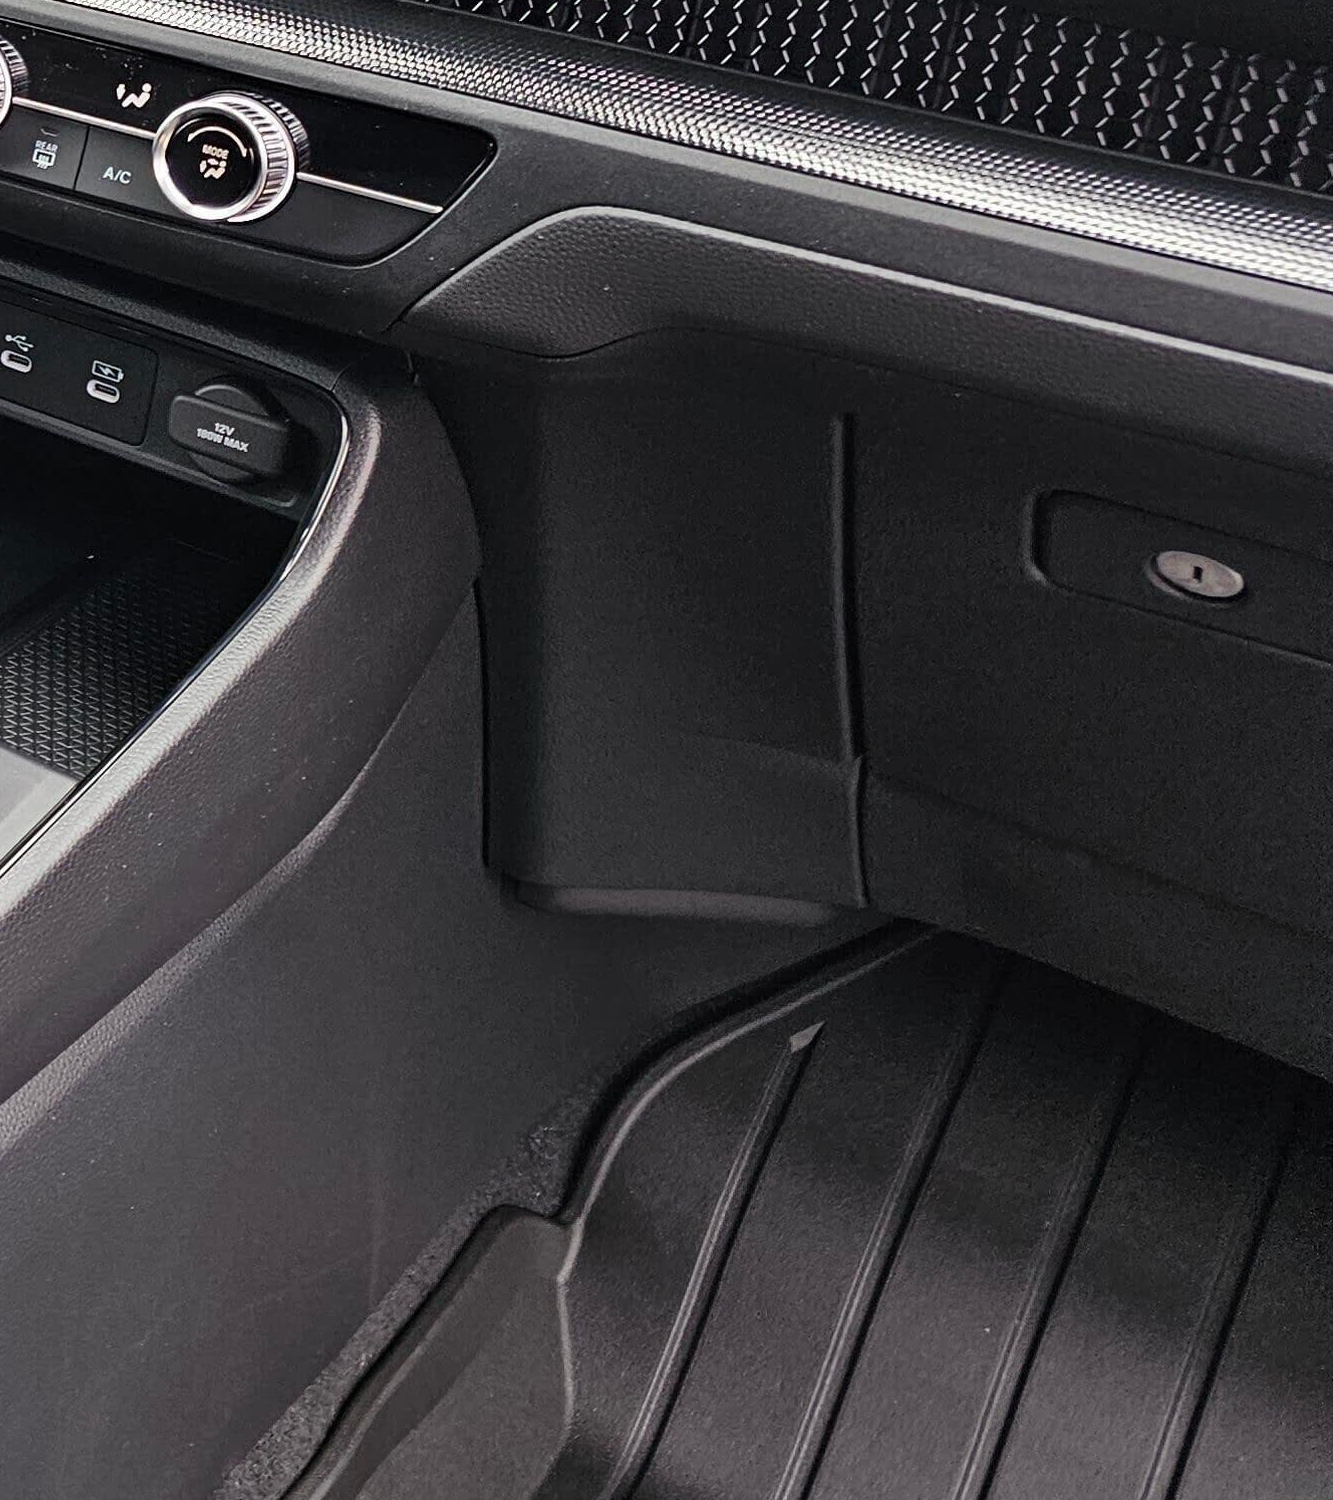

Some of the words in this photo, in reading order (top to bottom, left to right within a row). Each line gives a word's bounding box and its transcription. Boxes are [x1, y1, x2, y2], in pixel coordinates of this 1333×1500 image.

[35, 139, 58, 152] REAR
[202, 144, 230, 160] MODE
[102, 166, 132, 184] A/C
[214, 422, 235, 436] 12V
[223, 436, 250, 453] MAX
